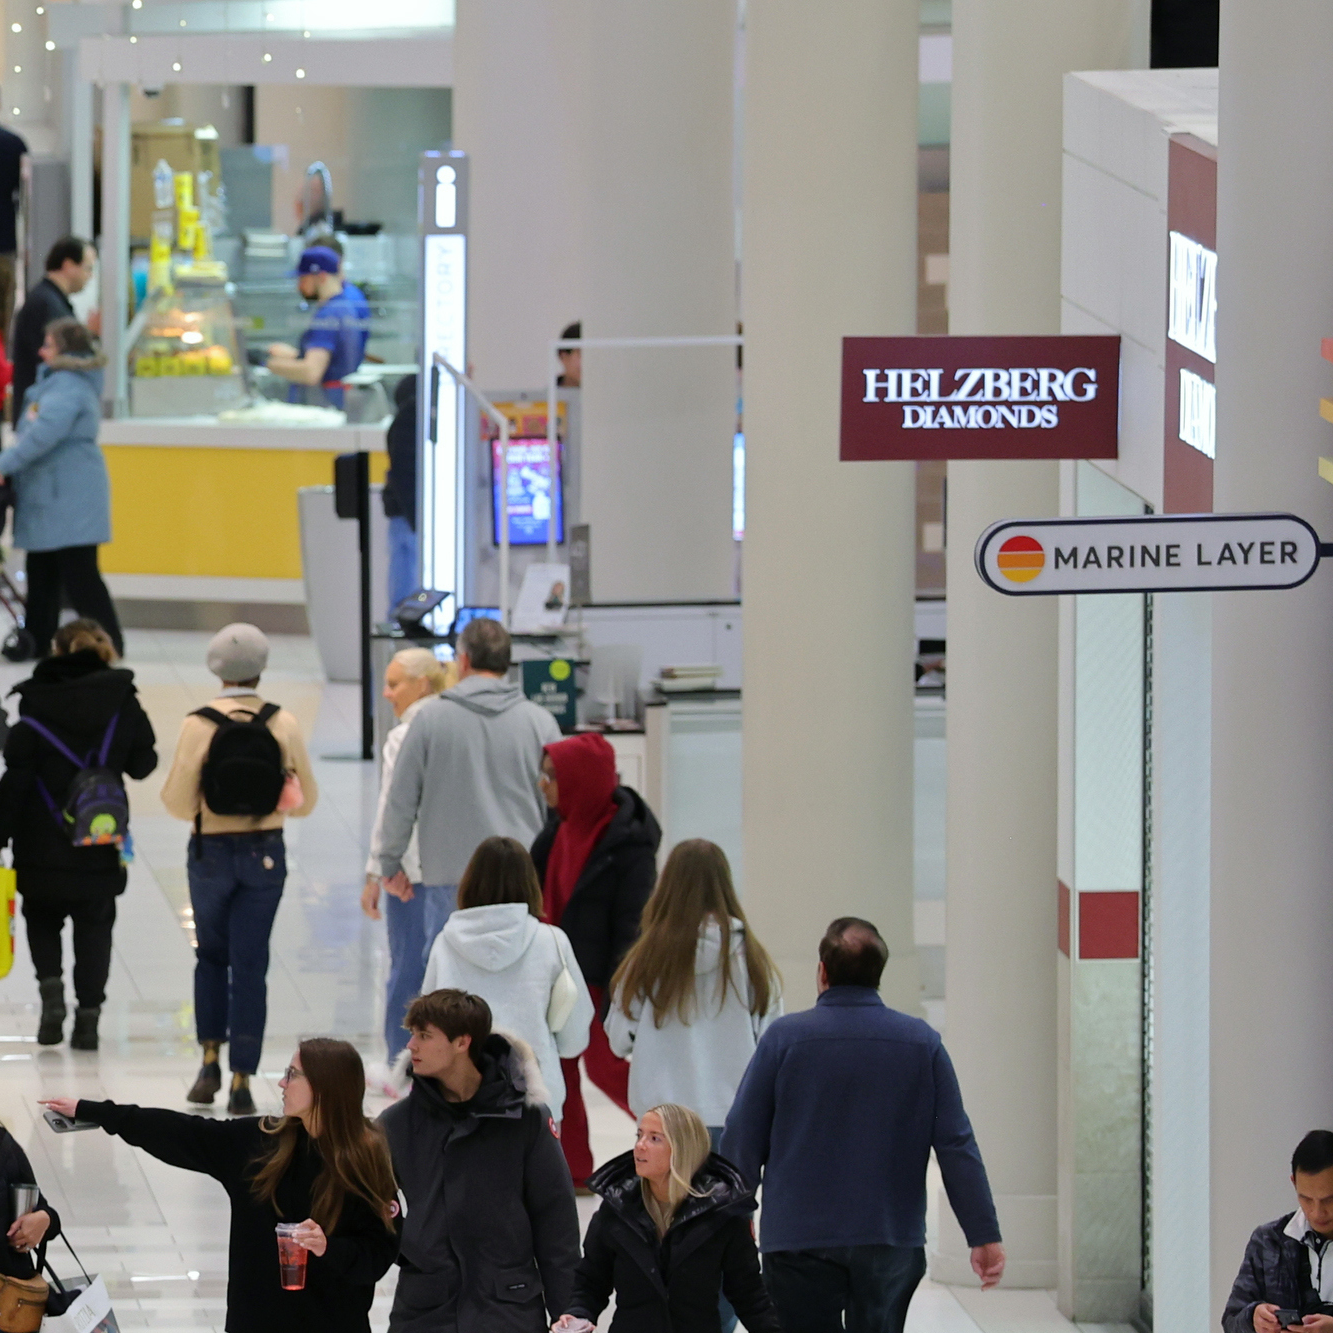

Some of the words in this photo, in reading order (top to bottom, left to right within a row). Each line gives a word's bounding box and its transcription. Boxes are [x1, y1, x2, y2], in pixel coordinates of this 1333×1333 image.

[437, 244, 452, 360] RECTORY
[862, 367, 1099, 402] HELZBERG
[901, 404, 1059, 429] DIAMONDS
[1054, 544, 1182, 569] MARINE
[1196, 541, 1299, 566] LAYER
